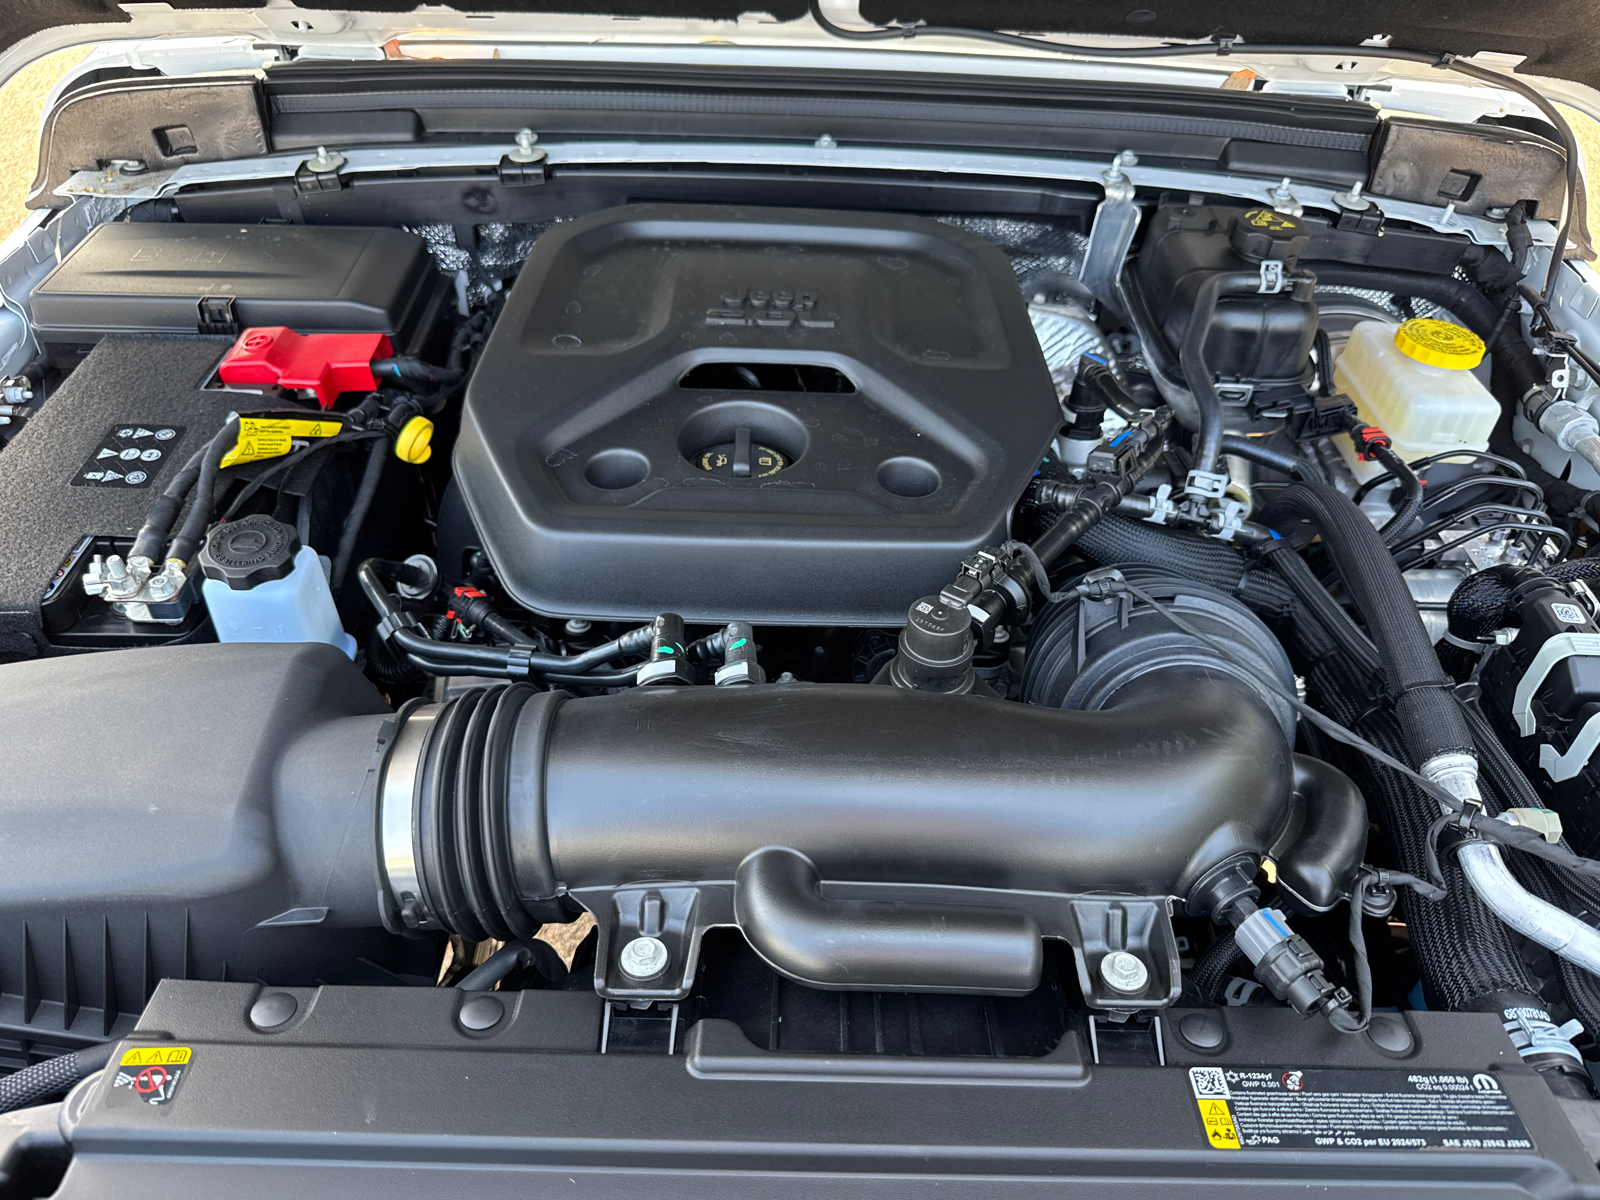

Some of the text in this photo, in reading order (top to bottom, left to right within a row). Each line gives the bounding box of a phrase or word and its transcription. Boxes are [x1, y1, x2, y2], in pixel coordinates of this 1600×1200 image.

[719, 287, 817, 312] Jeep
[1261, 1136, 1280, 1144] PAG
[1315, 1137, 1335, 1145] GWP
[1378, 1138, 1391, 1146] EU
